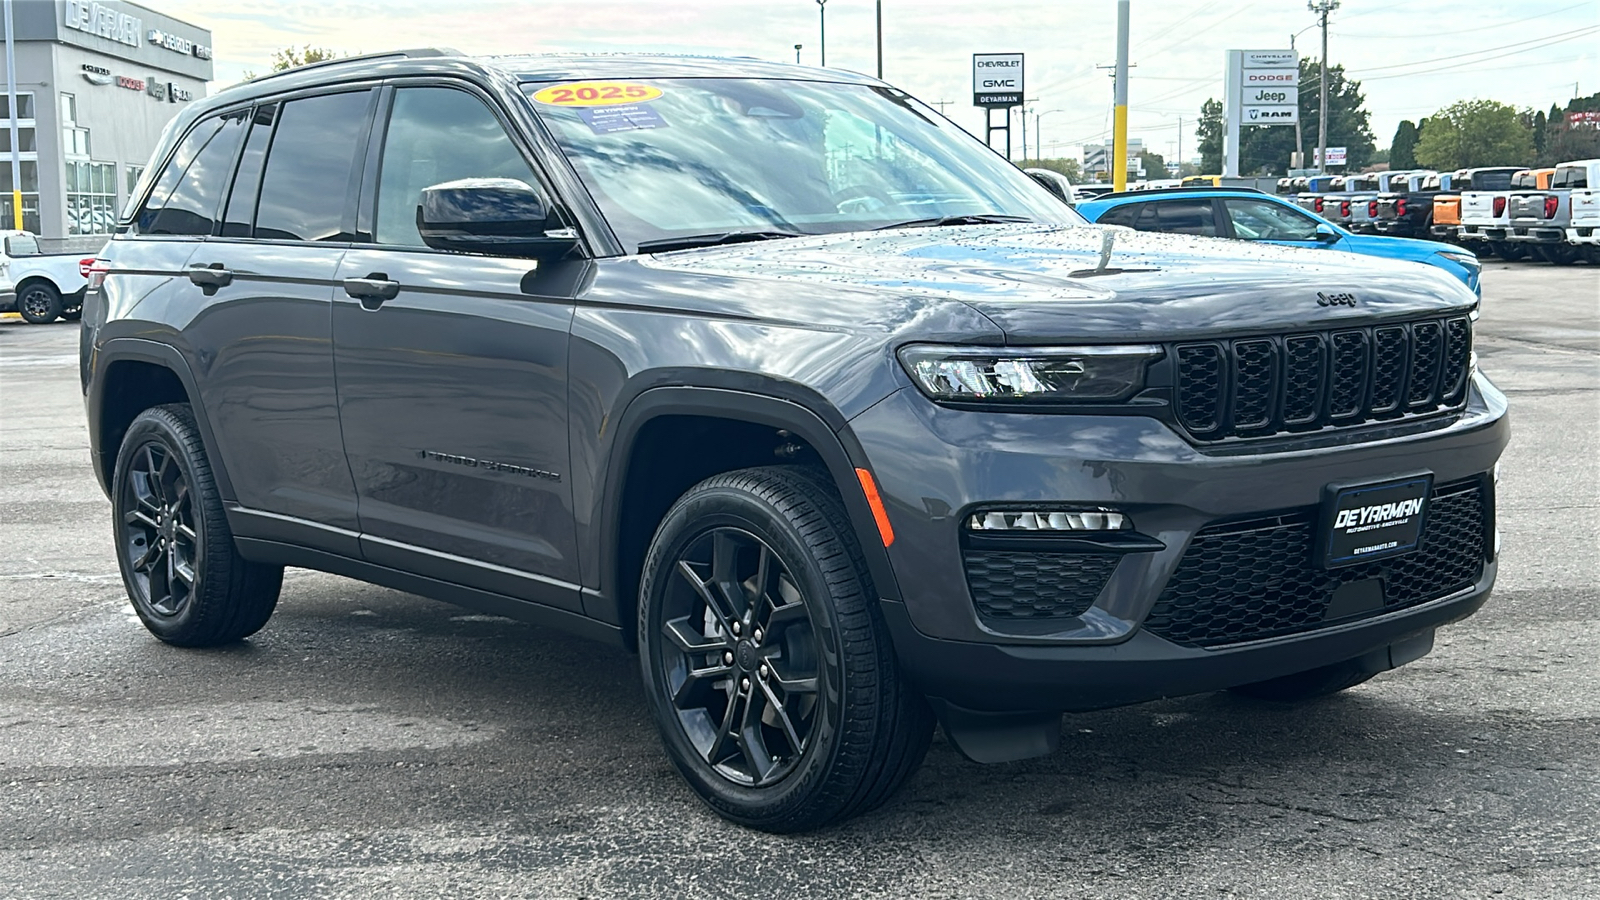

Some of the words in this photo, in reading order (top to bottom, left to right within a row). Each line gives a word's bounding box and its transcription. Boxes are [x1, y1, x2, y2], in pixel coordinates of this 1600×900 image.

[65, 1, 142, 48] DEYARMAN
[118, 76, 146, 91] DODGE
[983, 79, 1015, 87] GMC
[551, 86, 648, 103] 2025
[1255, 90, 1286, 103] Jeep
[1316, 291, 1357, 308] Jeep
[1333, 497, 1424, 529] DEYARMAN
